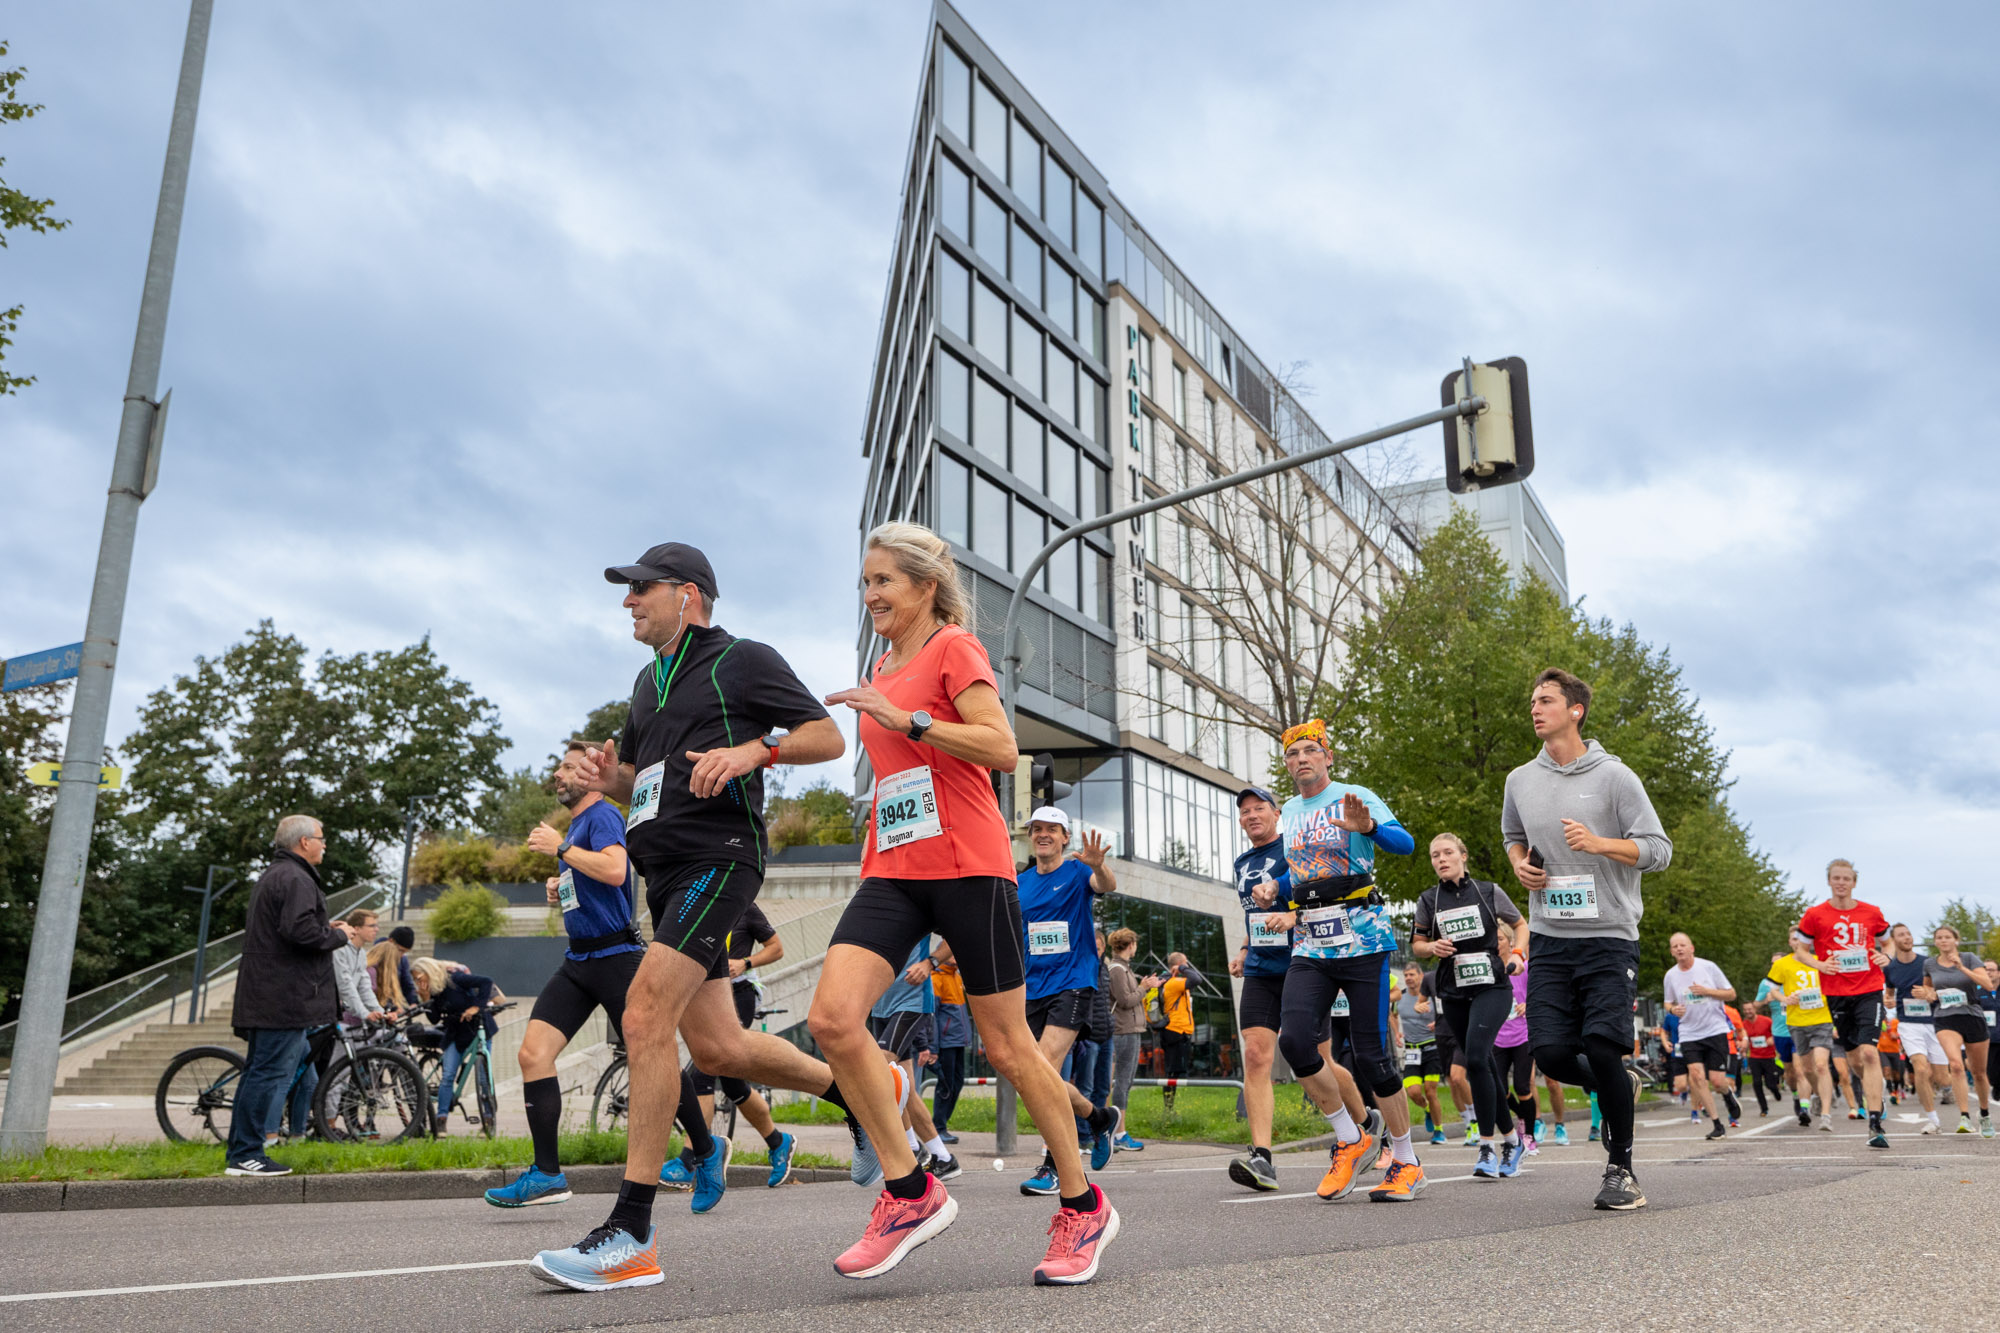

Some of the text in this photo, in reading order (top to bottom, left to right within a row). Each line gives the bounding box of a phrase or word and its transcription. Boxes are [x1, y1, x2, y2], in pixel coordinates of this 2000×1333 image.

[1127, 324, 1145, 641] PARK TOWER
[8, 656, 61, 683] Stuttgarter
[880, 798, 918, 828] 3942
[1283, 803, 1345, 836] HAWAII
[887, 830, 914, 845] Dagmar
[1307, 827, 1342, 844] 2021
[1550, 892, 1582, 906] 4133
[1313, 922, 1335, 937] 267
[1446, 919, 1476, 933] 8313-1
[1833, 922, 1860, 945] 31
[1036, 933, 1059, 945] 1551
[1462, 965, 1484, 976] 8313
[1795, 970, 1817, 987] 31
[599, 1243, 637, 1270] HOKA
